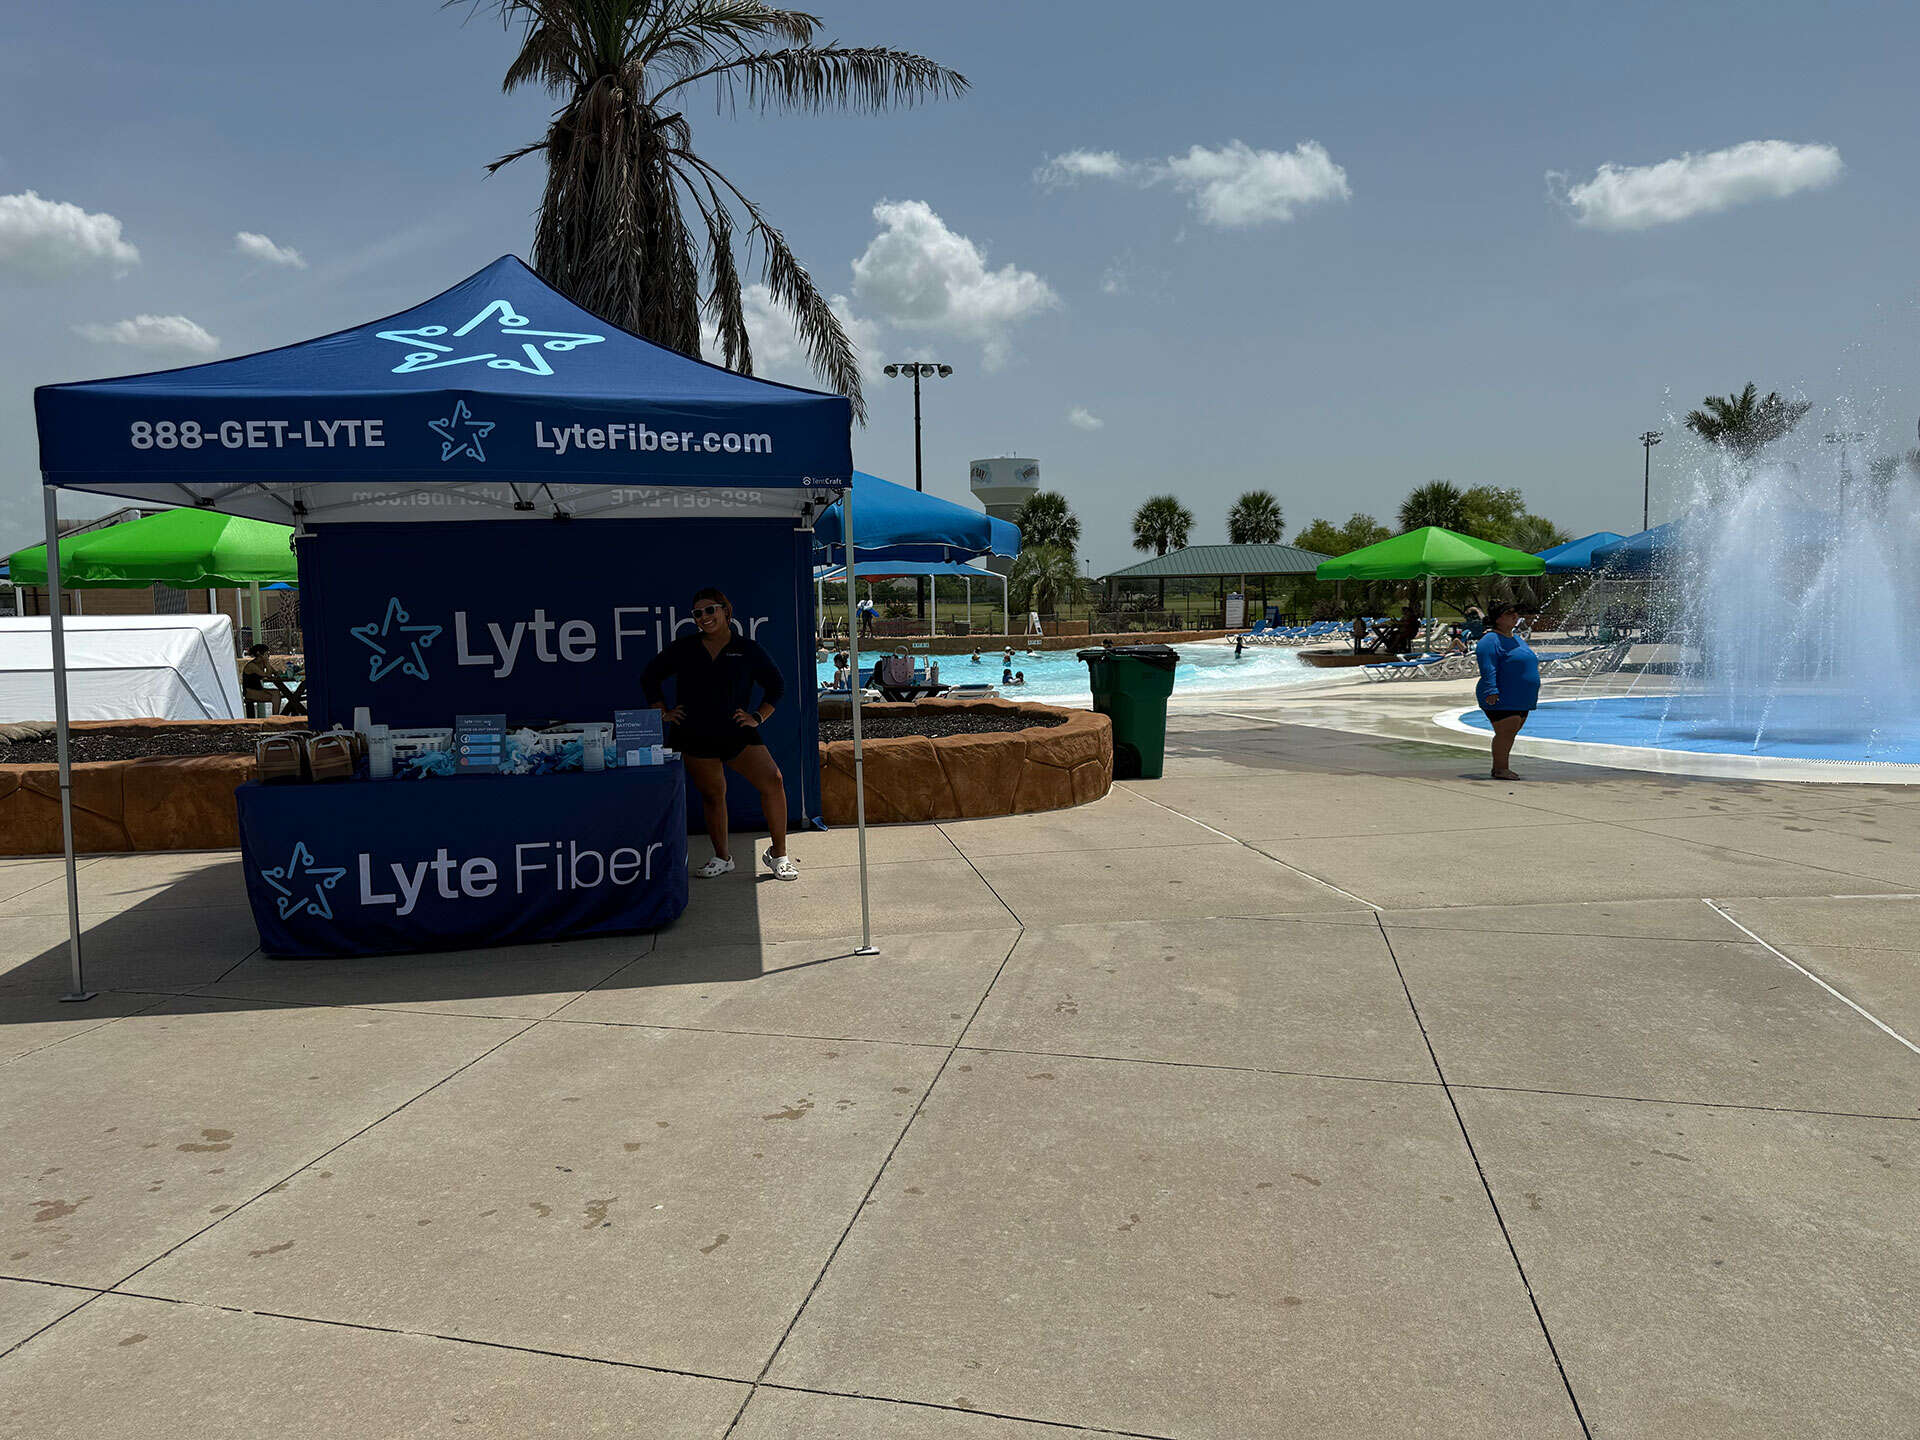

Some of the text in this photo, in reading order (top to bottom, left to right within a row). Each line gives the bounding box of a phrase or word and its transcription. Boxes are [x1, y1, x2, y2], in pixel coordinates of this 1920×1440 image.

[130, 420, 385, 450] 888-GET-LYTE
[535, 421, 773, 455] LyteFiber.com
[812, 477, 843, 486] TentCraft
[454, 608, 598, 679] Lyte
[358, 840, 663, 916] Lyte Fiber
